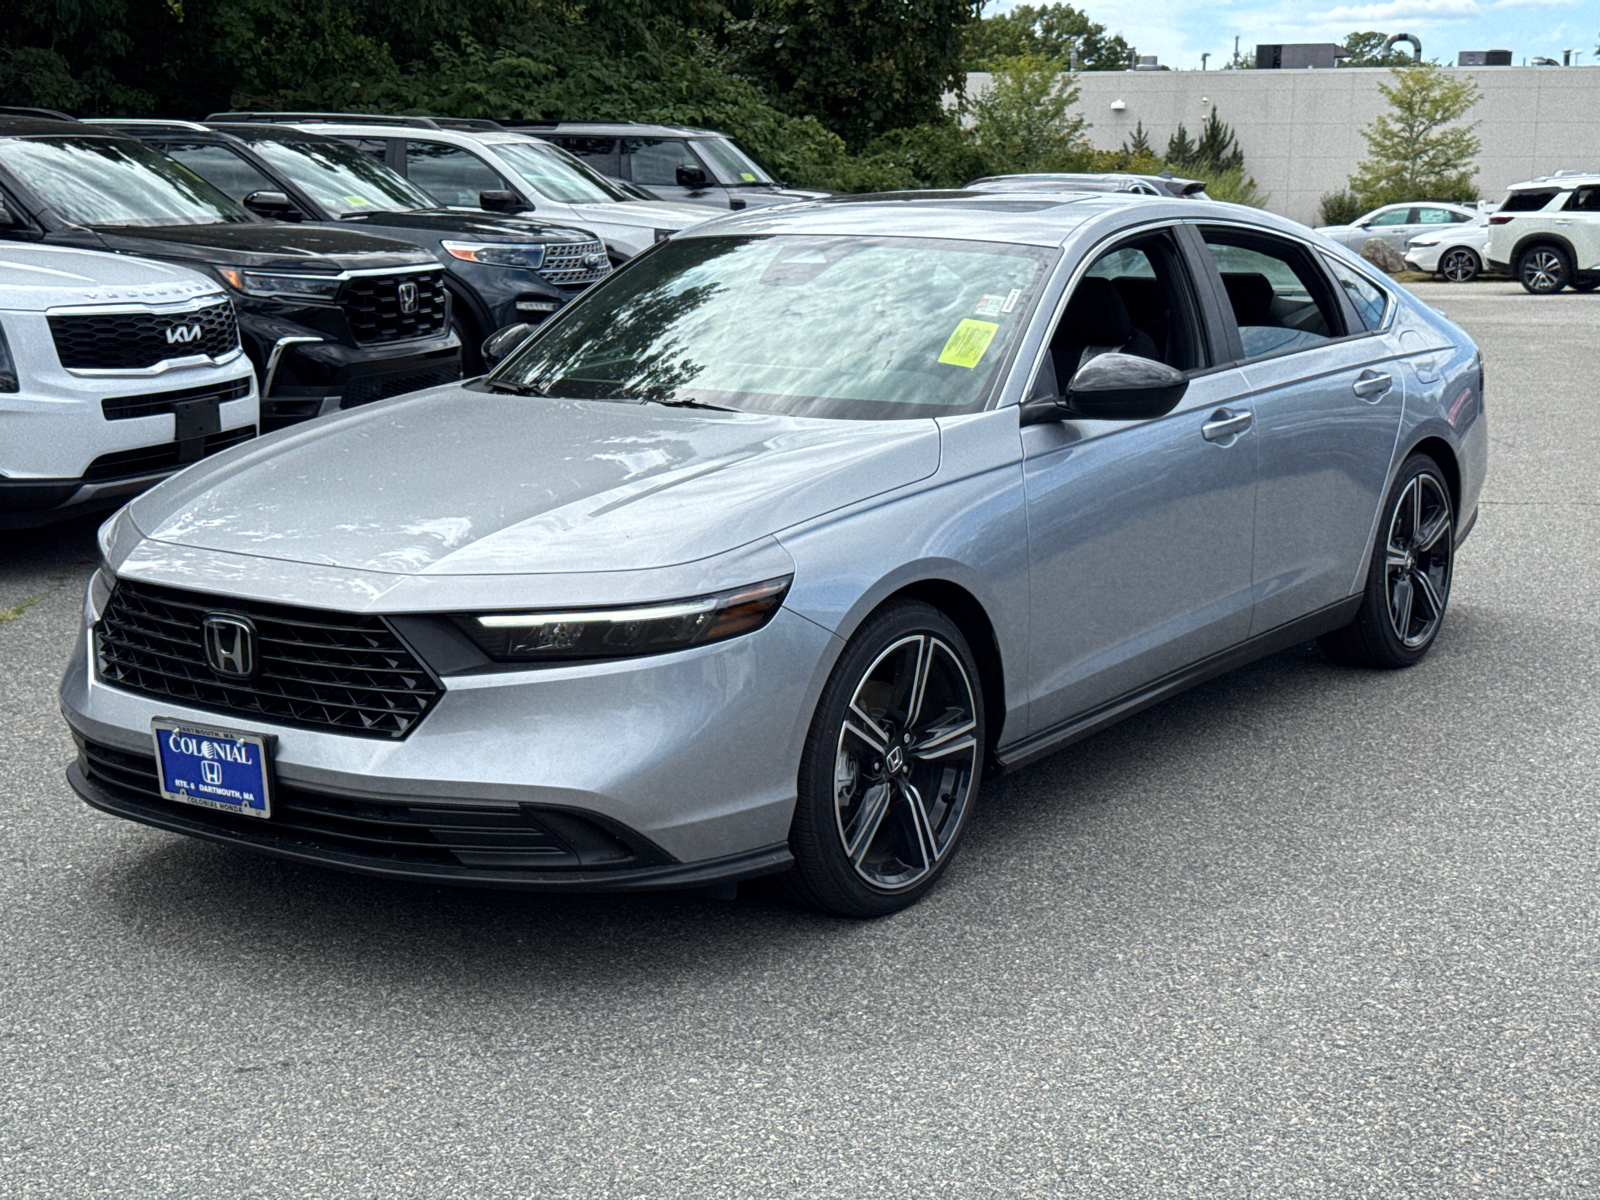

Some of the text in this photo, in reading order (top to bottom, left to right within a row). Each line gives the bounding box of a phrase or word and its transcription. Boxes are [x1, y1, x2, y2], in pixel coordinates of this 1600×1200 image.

[169, 735, 252, 764] COLONIAL
[199, 785, 242, 799] DARTMOUTH,
[243, 792, 254, 800] MA
[187, 797, 243, 812] COLONIAL HONDA
